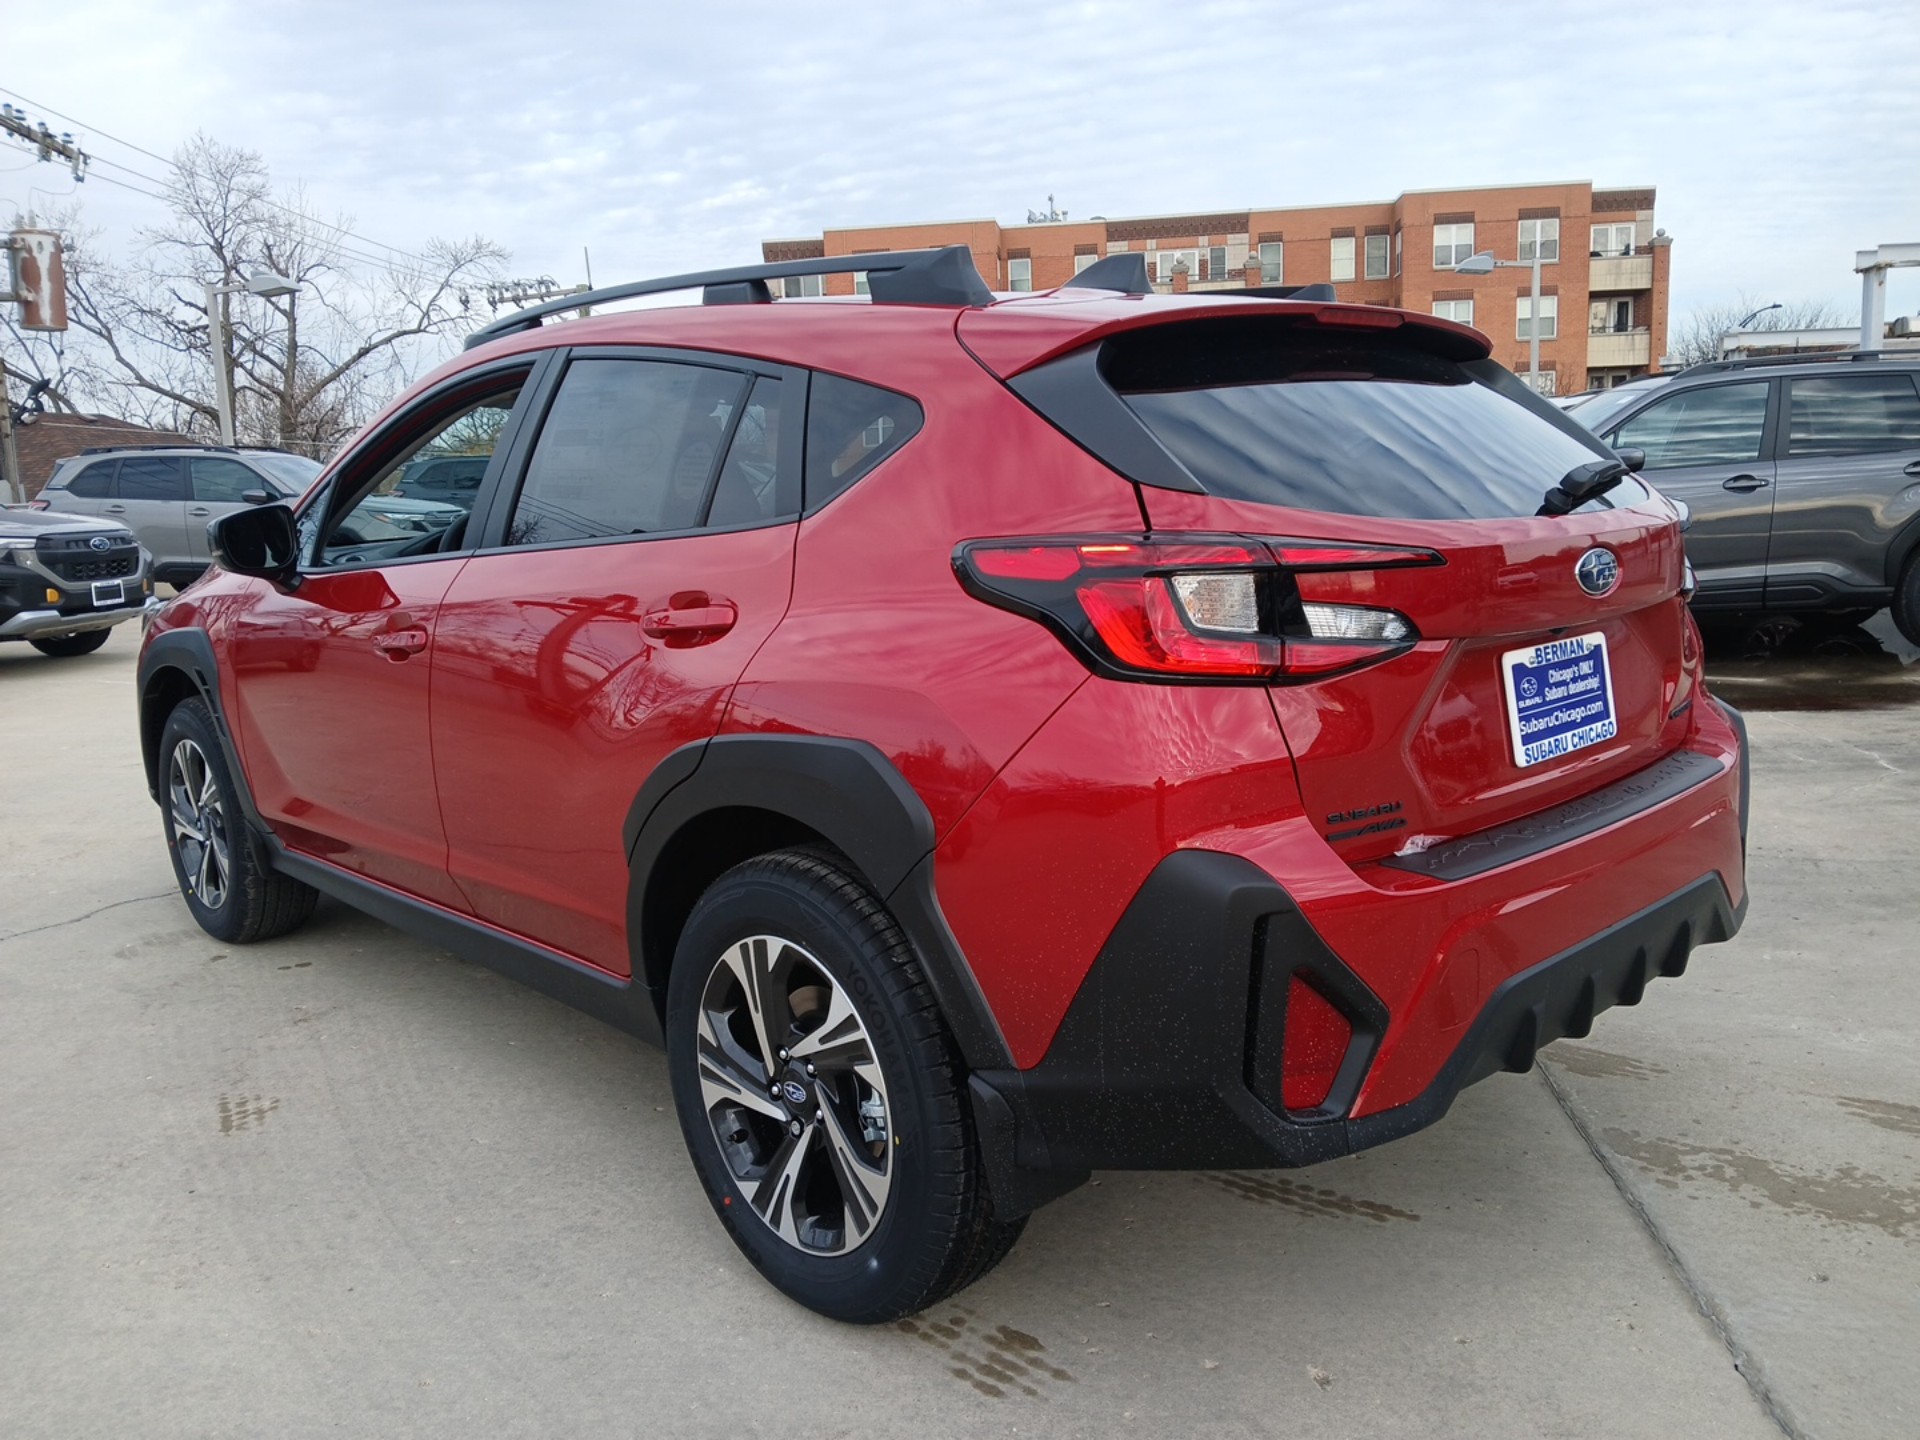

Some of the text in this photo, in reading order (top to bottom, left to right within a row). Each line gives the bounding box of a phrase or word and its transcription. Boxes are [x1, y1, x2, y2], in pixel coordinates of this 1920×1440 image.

[1535, 638, 1585, 664] BERMAN
[1548, 660, 1594, 684] Chicago's ONLY
[1518, 696, 1544, 709] SUBARU
[1544, 686, 1568, 701] Subaru
[1519, 701, 1604, 736] SubaruChicago.com
[1524, 721, 1615, 764] SUBARU CHICAGO
[1327, 800, 1403, 824] SUBARU
